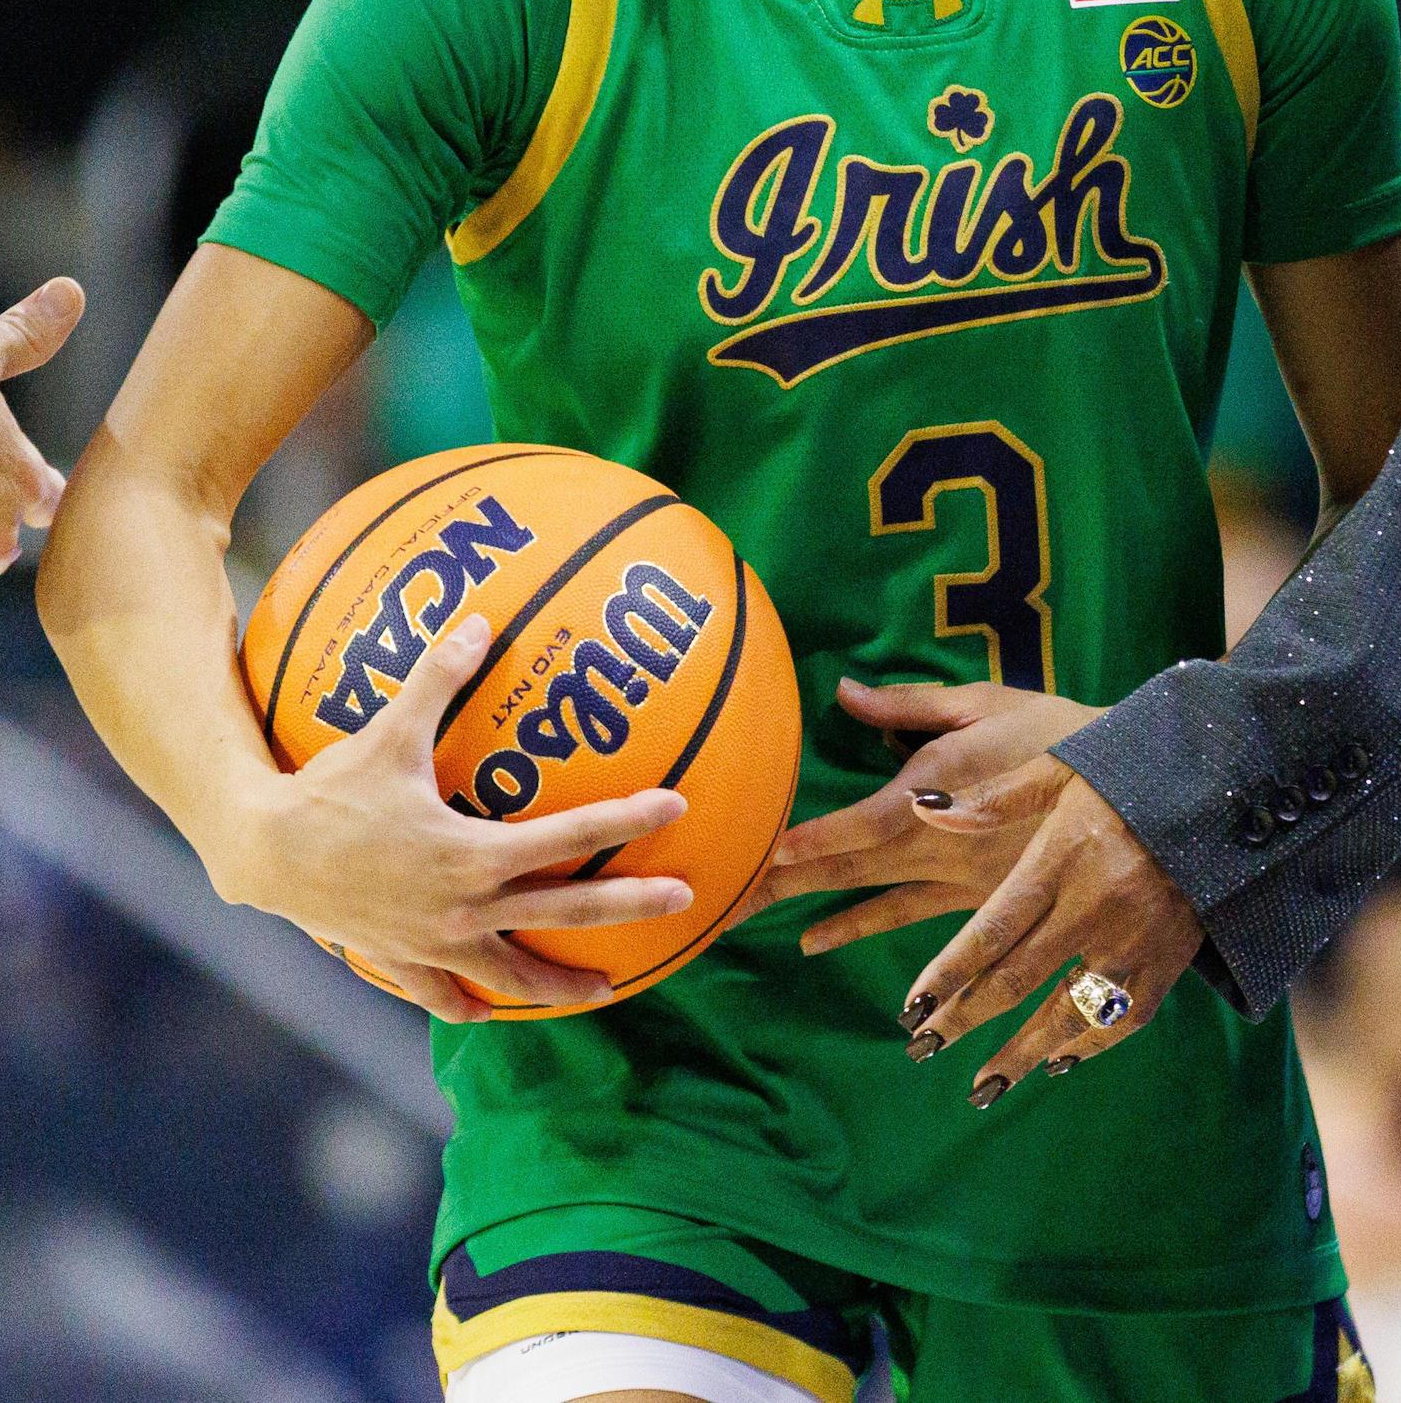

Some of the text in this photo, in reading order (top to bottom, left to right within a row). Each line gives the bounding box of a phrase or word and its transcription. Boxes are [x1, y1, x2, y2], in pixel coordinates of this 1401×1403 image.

[1129, 43, 1193, 71] ACC
[699, 91, 1167, 326] Irish
[390, 485, 482, 559] OFFICIAL
[867, 419, 1057, 697] 3
[312, 494, 539, 737] NCAA
[336, 564, 391, 633] GAME
[300, 638, 339, 705] BALL
[445, 560, 716, 823] Wilso
[490, 627, 573, 730] EVO NXT
